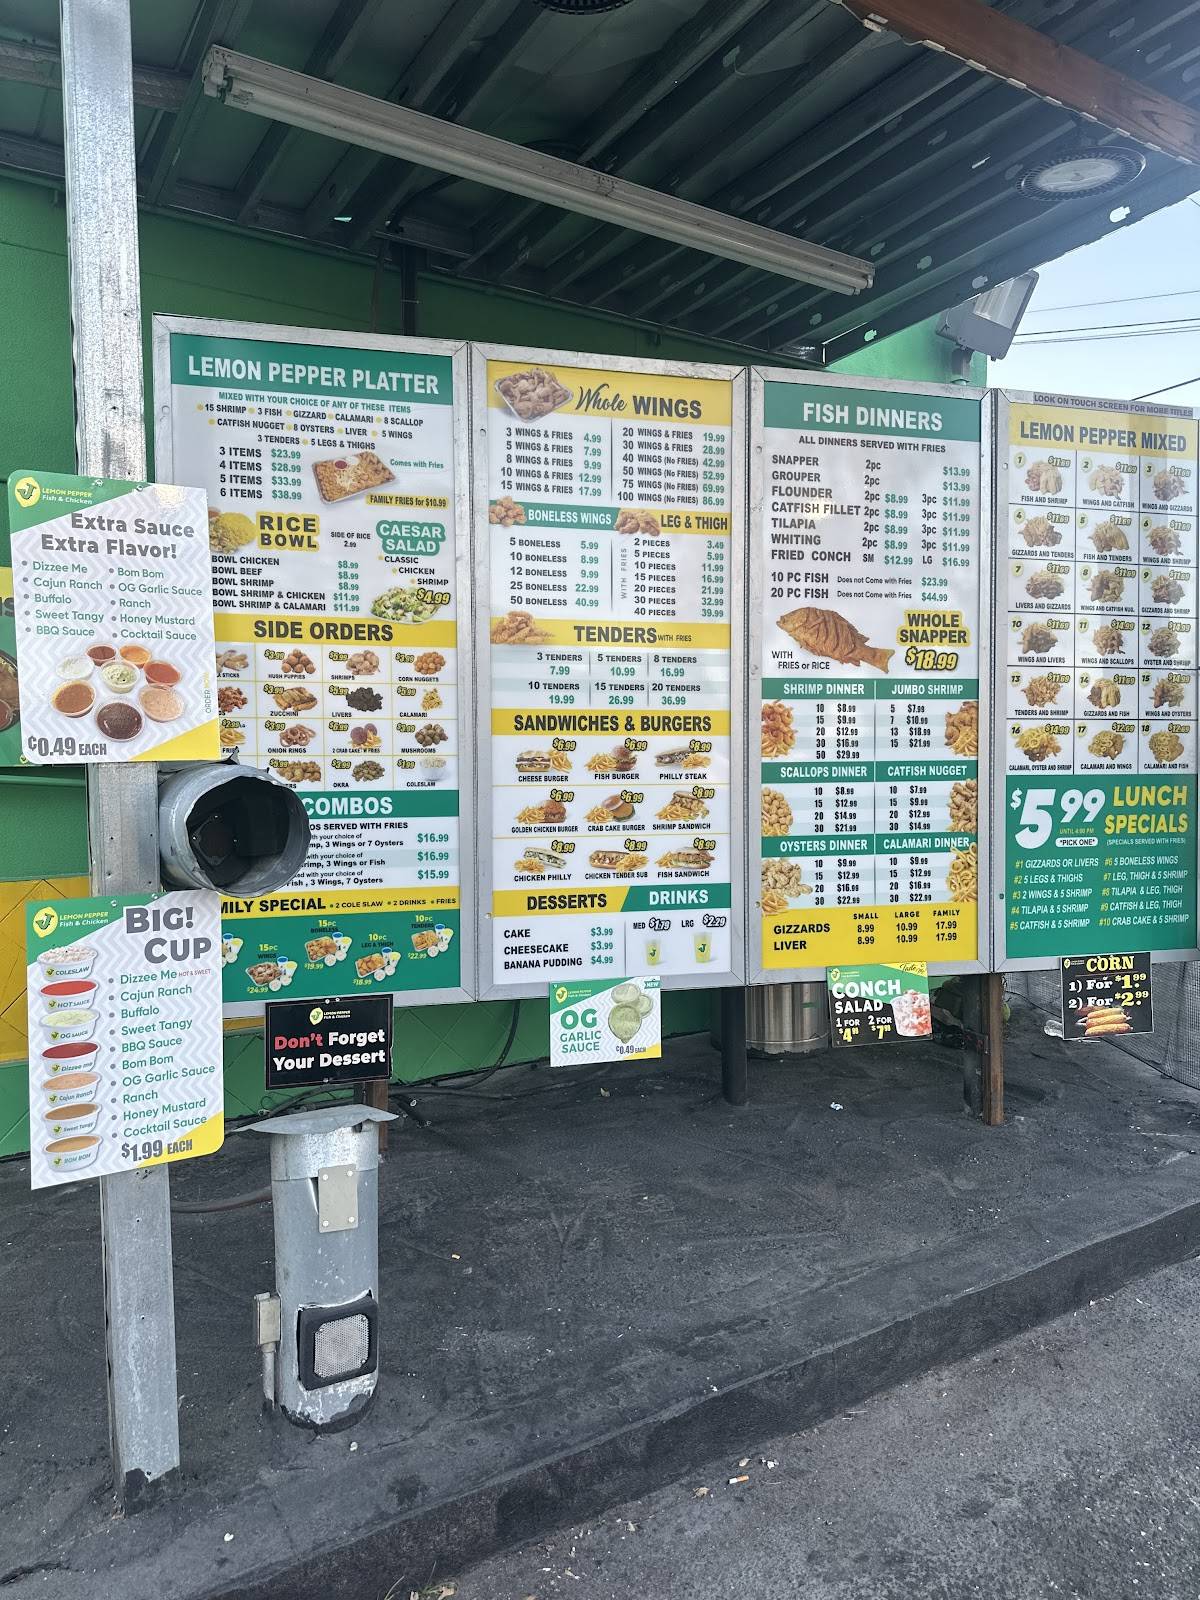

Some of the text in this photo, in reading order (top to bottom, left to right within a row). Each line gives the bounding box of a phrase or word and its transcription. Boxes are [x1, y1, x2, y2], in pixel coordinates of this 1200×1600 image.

[188, 355, 439, 394] LEMON PEPPER PLATTER
[219, 392, 411, 413] MIXED WITH YOUR CHOICE OF ANY OF THESE ITEMS
[575, 383, 702, 419] Whole WINGS
[803, 402, 942, 431] FISH DINNERS
[507, 428, 512, 437] 3
[515, 428, 541, 437] WINGS
[552, 430, 573, 439] FRIES
[584, 433, 601, 443] 4.99
[1020, 421, 1186, 452] LEMON PEPPER MIXED
[220, 447, 300, 459] 3 ITEMS $23.99
[220, 461, 301, 473] 4 ITEMS $28.99
[390, 459, 410, 468] Comes
[427, 461, 444, 469] Fries
[623, 454, 725, 467] 40 WINGS (No FRIES) 42.99
[772, 455, 970, 477] SNAPPER 2pc $13.99
[42, 488, 92, 498] LEMON PEPPER
[1048, 497, 1068, 505] SHRIMP
[528, 509, 611, 524] BONELESS WINGS
[772, 502, 970, 522] CATFISH FILLET 2pc $8.99 3pc $11.99
[71, 513, 194, 537] Extra Sauce
[259, 515, 316, 532] RICE
[661, 514, 727, 529] LEG & THIGH
[379, 524, 442, 539] CAESAR
[41, 534, 176, 558] Extra Flavor!
[260, 534, 317, 548] BOWL
[386, 539, 435, 552] SALAD
[510, 537, 598, 550] 5 BONELESS 5.99
[211, 556, 358, 569] BOWL CHICKEN $8.99
[384, 556, 419, 564] CLASSIC
[399, 567, 435, 575] CHICKEN
[771, 572, 829, 584] 10 PC FISH
[34, 578, 102, 590] Cajun Ranch
[417, 578, 449, 586] SHRIMP
[120, 614, 194, 626] Honey Mustard
[908, 614, 959, 628] WHOLE
[254, 620, 393, 641] SIDE ORDERS
[574, 625, 692, 643] TENDERS WITH FRIES
[900, 630, 967, 644] SNAPPER
[537, 652, 582, 662] 3 TENDERS
[905, 647, 958, 671] $18.99
[550, 665, 570, 676] 7.99
[783, 683, 864, 695] SHRIMP DINNER
[891, 684, 963, 695] JUMBO SHRIMP
[514, 714, 711, 732] SANDWICHES & BURGERS
[78, 742, 107, 756] EACH
[518, 774, 568, 783] CHEESE BURGER
[659, 772, 707, 781] PHILLY STEAK
[1113, 785, 1187, 806] LUNCH
[305, 796, 392, 816] COMBOS
[1104, 813, 1188, 834] SPECIALS
[417, 833, 448, 843] $16.99
[1016, 858, 1098, 868] #1 GIZZARDS OR LIVERS
[527, 893, 607, 910] DESSERTS
[649, 889, 708, 905] DRINKS
[259, 899, 326, 911] SPECIAL
[126, 906, 194, 934] BIG!
[504, 926, 613, 939] CAKE $3.99
[773, 921, 957, 935] GIZZARDS 8.99 10.99 17.99
[144, 937, 212, 964] CUP
[504, 940, 613, 955] CHEESECAKE $3.99
[1086, 956, 1134, 972] CORN
[832, 980, 901, 998] CONCH
[121, 1006, 160, 1018] Buffalo
[834, 1000, 883, 1014] SALAD
[560, 1009, 597, 1029] OG
[122, 1019, 192, 1036] Sweet Tangy
[274, 1029, 385, 1050] Don't Forget
[559, 1030, 601, 1042] GARLIC
[122, 1036, 182, 1053] BBQ Sauce
[561, 1040, 600, 1054] SAUCE
[273, 1050, 386, 1071] Your Dessert
[123, 1090, 158, 1104] Ranch
[122, 1139, 192, 1162] $1.99 EACH
